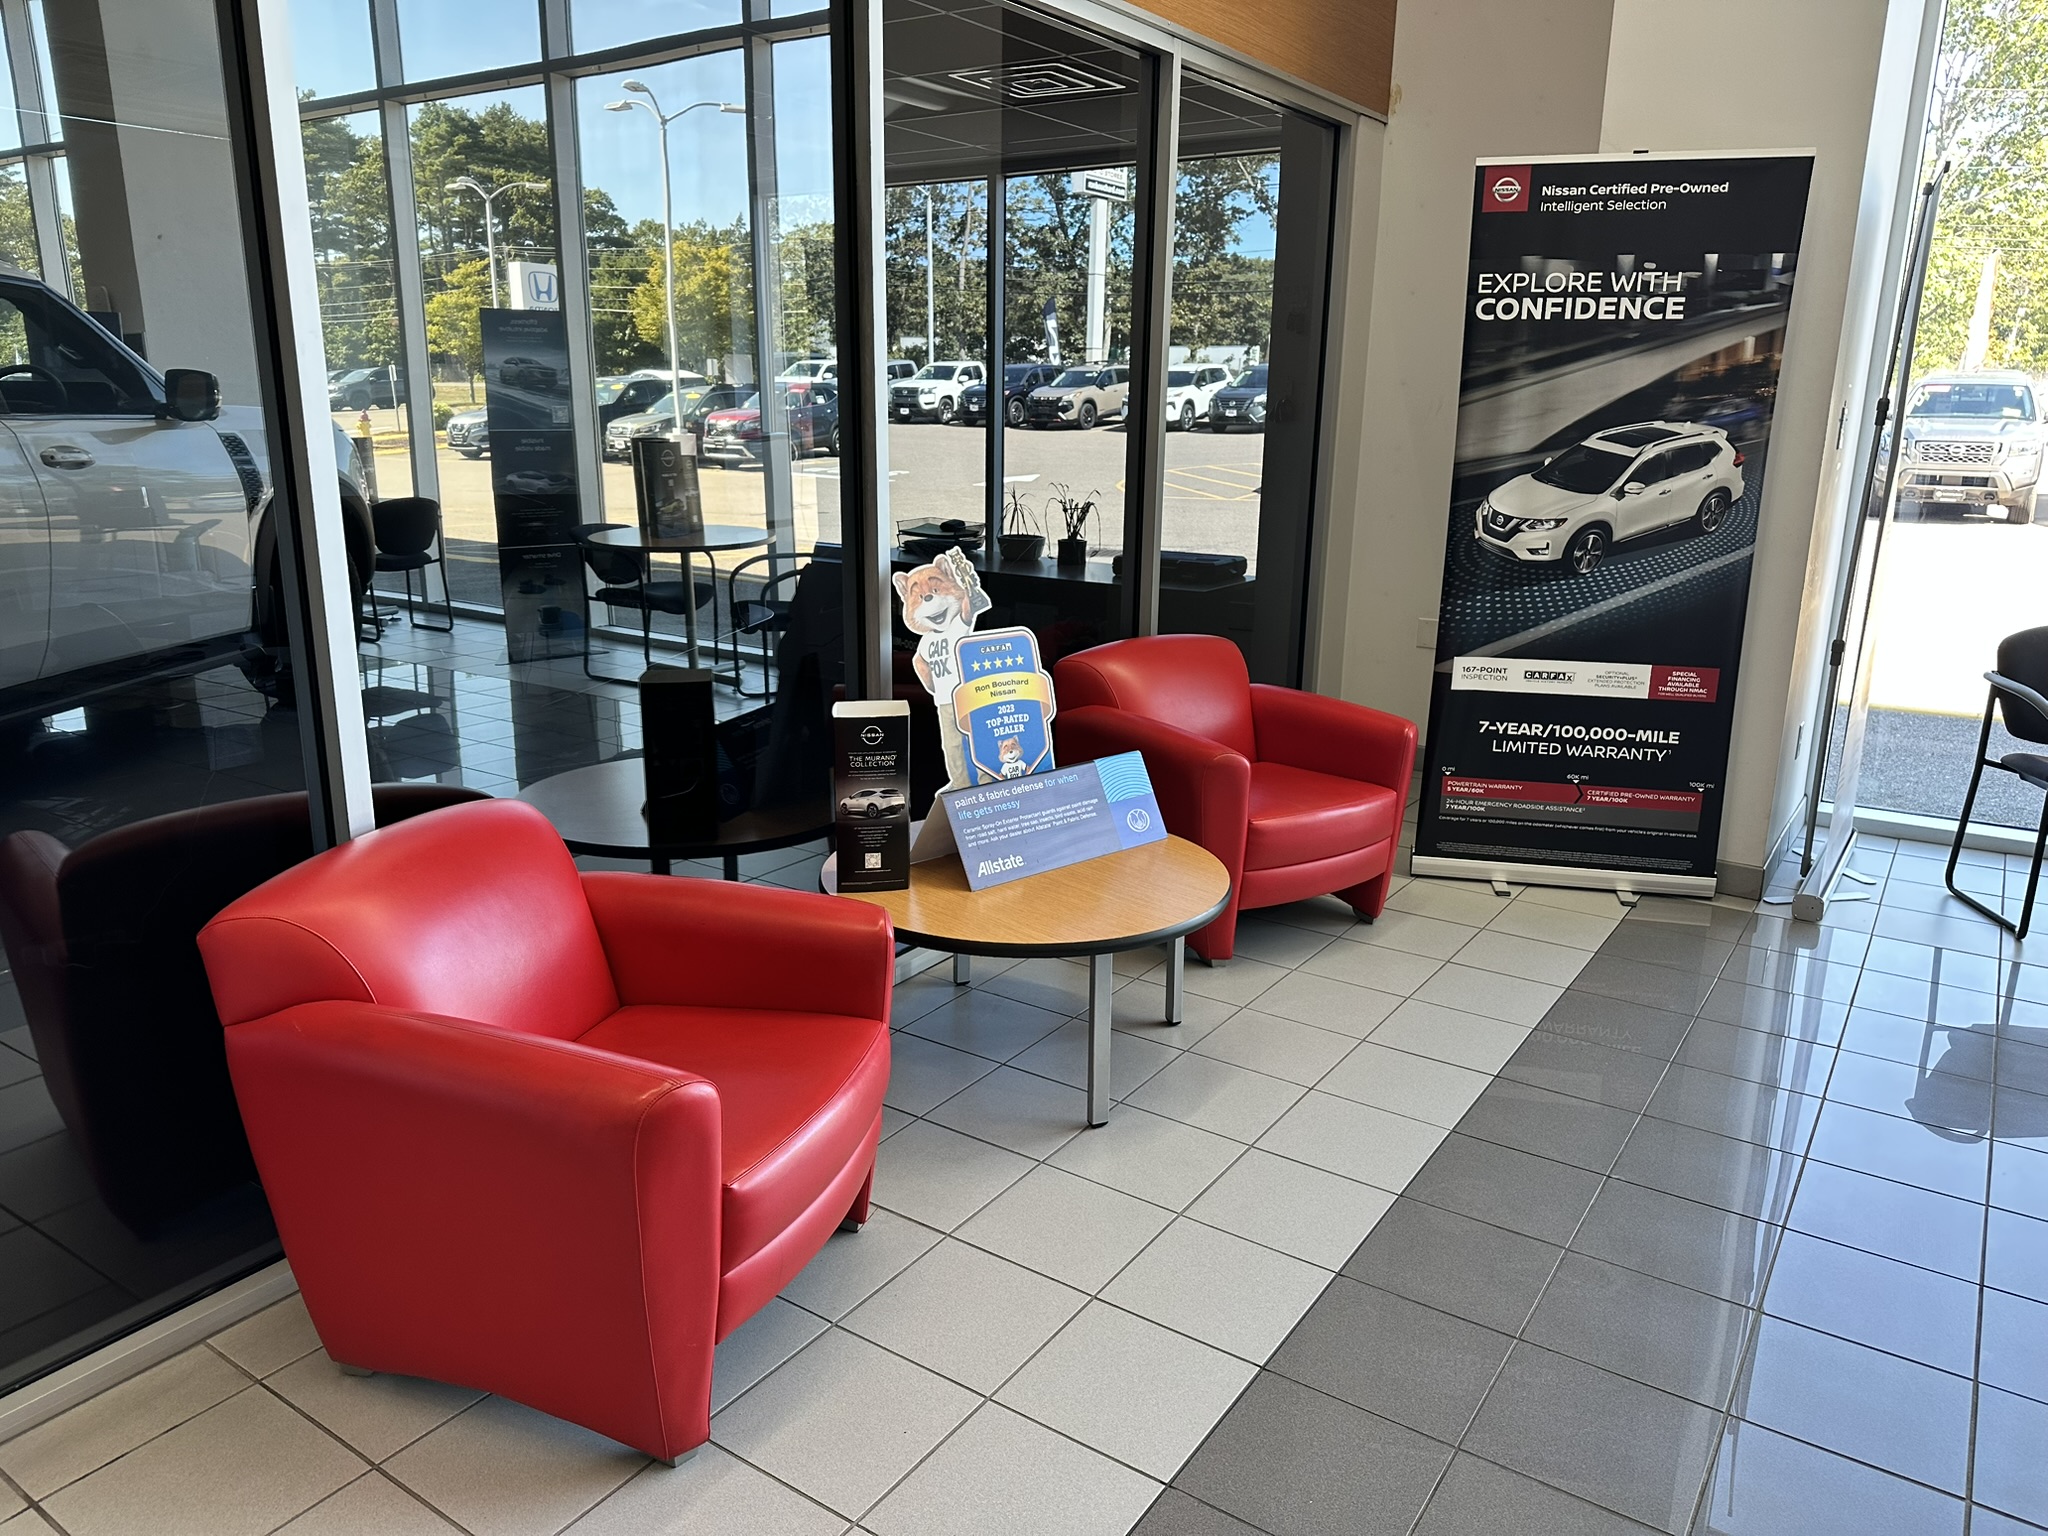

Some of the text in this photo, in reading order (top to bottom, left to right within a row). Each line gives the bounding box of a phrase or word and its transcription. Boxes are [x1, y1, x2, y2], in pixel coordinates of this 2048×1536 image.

[1541, 181, 1730, 196] Nissan Certified Pre-Owned
[1540, 199, 1667, 214] Intelligent Selection
[1478, 271, 1683, 294] EXPLORE WITH
[1475, 296, 1686, 321] CONFIDENCE
[928, 638, 949, 659] CAR
[930, 657, 952, 678] FOX
[1462, 666, 1508, 674] 167-POINT
[1460, 673, 1508, 682] INSPECTION
[1524, 670, 1576, 682] CARFAX
[974, 678, 1029, 694] Ron Bouchard
[990, 688, 1017, 698] Nissan
[997, 704, 1015, 715] 2023
[986, 713, 1030, 729] TOP-RATED
[993, 724, 1025, 737] DEALER
[1478, 720, 1681, 745] 7-YEAR/100,000-MILE
[1492, 739, 1562, 756] LIMITED
[849, 760, 895, 768] COLLECTION
[1008, 766, 1020, 774] CAR
[954, 774, 1079, 810] paint & fabric defense for when
[1447, 780, 1523, 791] POWERTRAIN WARRANTY
[1452, 786, 1485, 794] YEAR/60K
[1587, 789, 1696, 802] CERTIFIED PRE-OWNED WARRANTY
[1592, 796, 1628, 804] YEAR/100K
[957, 799, 1020, 821] life gets messy
[1446, 798, 1474, 806] 24-HOUR
[1474, 800, 1513, 808] EMERGENCY
[1513, 803, 1545, 811] ROADSIDE
[1450, 804, 1486, 812] YEAR/100K
[977, 854, 1025, 878] Allstate
